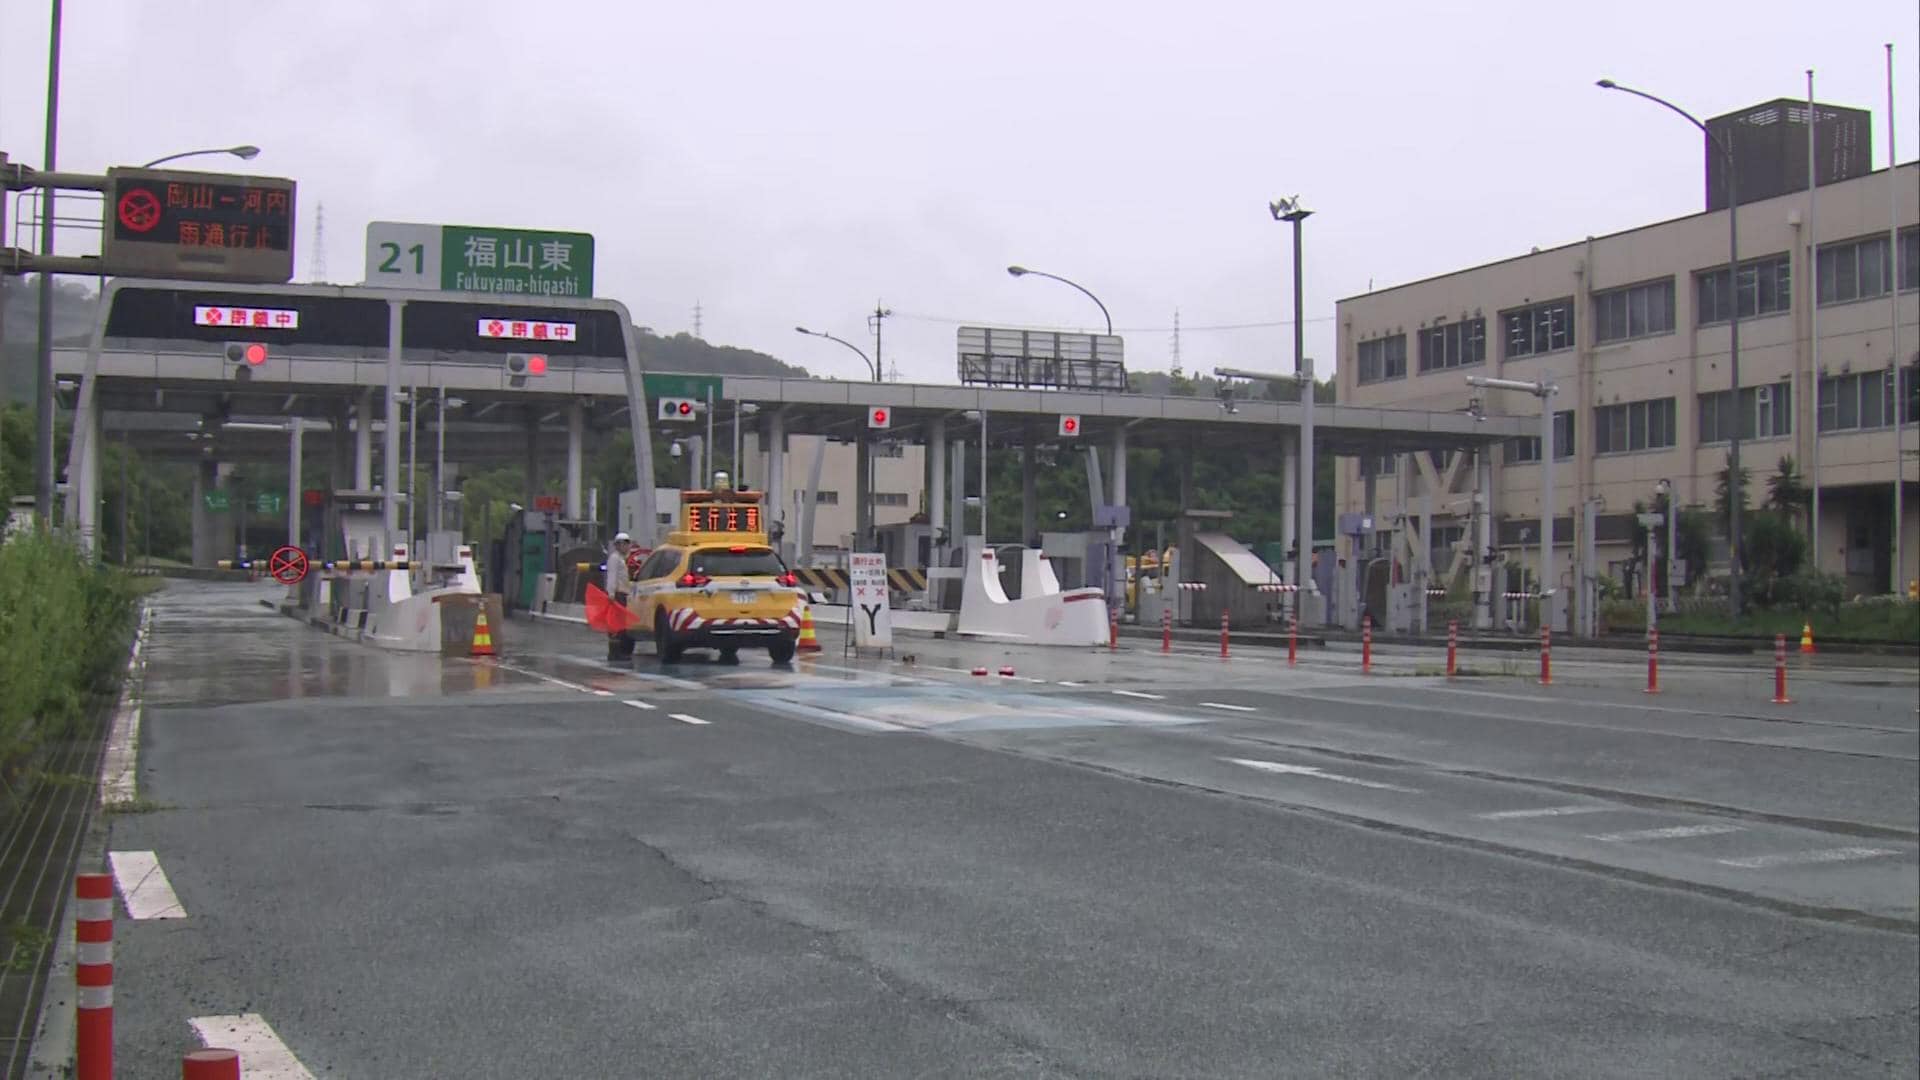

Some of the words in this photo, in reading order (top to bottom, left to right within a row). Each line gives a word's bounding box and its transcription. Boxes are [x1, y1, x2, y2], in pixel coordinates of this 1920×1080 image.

[178, 220, 272, 248] 雨通行止
[379, 242, 425, 275] 21
[464, 235, 573, 271] 福山東
[456, 271, 578, 296] Fukuyama-higashi
[689, 506, 758, 531] 走行注意
